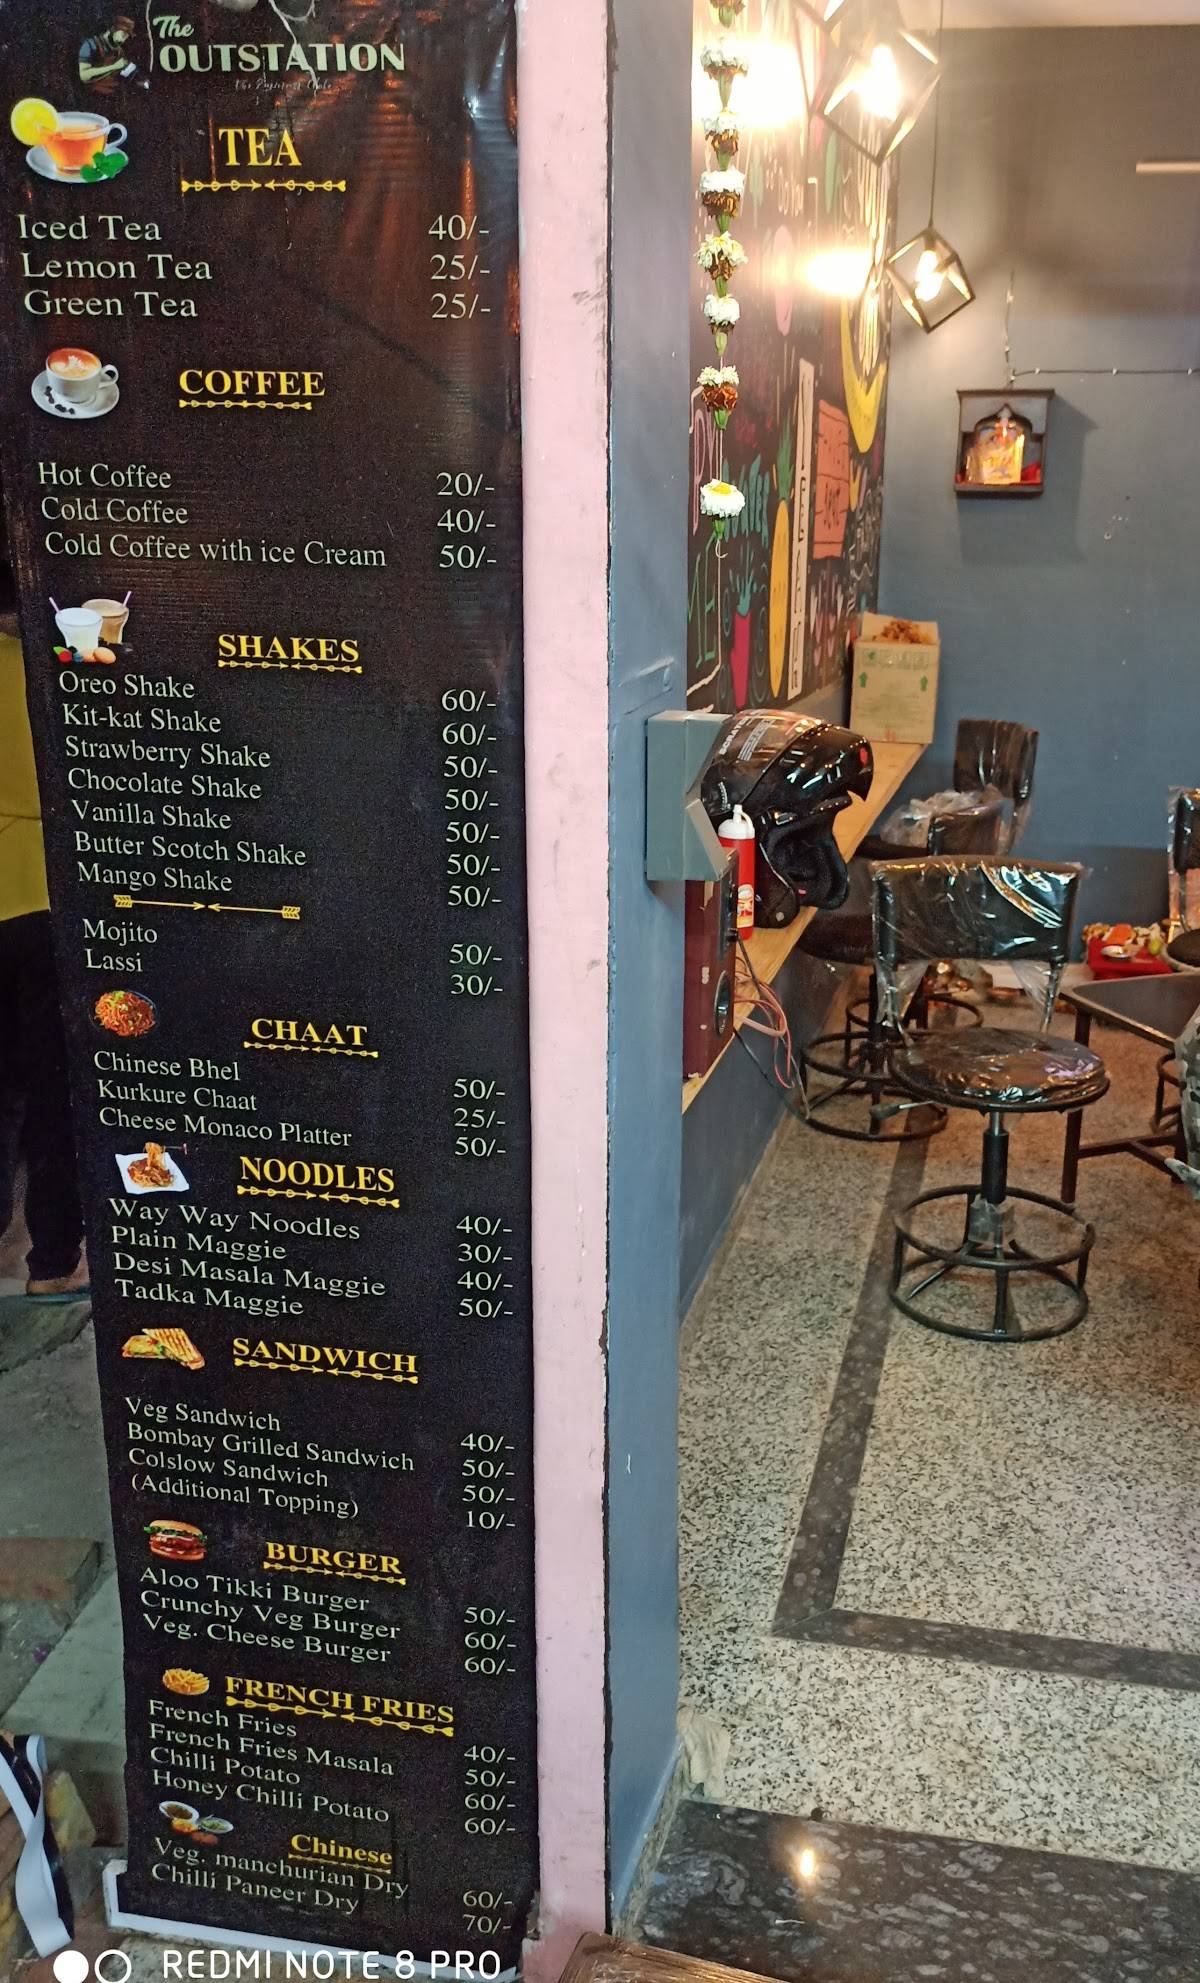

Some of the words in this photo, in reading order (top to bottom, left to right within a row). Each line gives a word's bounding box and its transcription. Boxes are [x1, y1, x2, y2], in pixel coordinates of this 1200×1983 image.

[153, 16, 193, 38] The
[159, 43, 405, 72] OUTSTATION
[219, 128, 301, 166] TEA
[18, 214, 88, 240] Iced
[99, 216, 161, 241] Tea
[429, 214, 489, 241] 40/-
[22, 253, 136, 279] Lemon
[148, 255, 212, 280] Tea
[431, 254, 490, 281] 25/-
[25, 291, 123, 317] Green
[134, 292, 197, 318] Tea
[431, 293, 491, 320] 25/-
[180, 370, 325, 396] COFFEE
[38, 463, 82, 487] Hot
[90, 464, 171, 488] Coffee
[437, 472, 494, 497] 20/-
[41, 497, 98, 522] Cold
[106, 499, 188, 524] Coffee
[438, 508, 496, 533] 40/-
[45, 532, 101, 556] Cold
[110, 534, 190, 559] Coffee
[200, 538, 252, 562] with
[261, 540, 295, 563] ice
[304, 541, 386, 567] Cream
[439, 544, 496, 569] 50/-
[219, 634, 360, 663] SHAKES
[59, 671, 116, 695] Oreo
[124, 675, 195, 699] Shake
[442, 689, 496, 713] 60/-
[63, 704, 143, 729] Kit-kat
[151, 708, 221, 733] Shake
[442, 723, 497, 746] 60/-
[66, 737, 191, 768] Strawberry
[201, 742, 271, 768] Shake
[444, 757, 498, 779] 50/-
[68, 768, 183, 795] Chocolate
[191, 774, 261, 800] Shake
[444, 789, 499, 812] 50/-
[71, 800, 155, 826] Vanilla
[162, 805, 231, 830] Shake
[446, 822, 500, 844] 50/-
[75, 832, 144, 857] Butter
[153, 836, 228, 862] Scotch
[237, 841, 306, 866] Shake
[447, 854, 500, 876] 50/-
[78, 862, 156, 891] Mango
[164, 867, 232, 892] Shake
[448, 885, 501, 908] 50/-
[83, 919, 158, 946] Mojito
[450, 944, 502, 966] 50/-
[85, 948, 143, 973] Lassi
[450, 975, 503, 997] 30/-
[251, 1018, 367, 1046] CHAAT
[94, 1050, 181, 1077] Chinese
[189, 1058, 240, 1081] Bhel
[454, 1078, 505, 1100] 50/-
[99, 1079, 186, 1105] Kurkure
[194, 1087, 257, 1111] Chaat
[454, 1107, 505, 1129] 25/-
[99, 1107, 176, 1133] Cheese
[184, 1115, 273, 1141] Monaco
[280, 1123, 352, 1147] Platter
[454, 1136, 506, 1158] 50/-
[241, 1156, 395, 1192] NOODLES
[109, 1198, 169, 1226] Way
[178, 1204, 239, 1232] Way
[250, 1212, 360, 1240] Noodles
[457, 1216, 513, 1237] 40/-
[111, 1226, 177, 1250] Plain
[187, 1233, 287, 1262] Maggie
[457, 1244, 513, 1264] 30/-
[114, 1252, 171, 1275] Desi
[181, 1259, 274, 1287] Masala
[283, 1269, 386, 1299] Maggie
[457, 1272, 513, 1292] 40/-
[115, 1279, 195, 1305] Tadka
[204, 1288, 304, 1318] Maggie
[458, 1299, 513, 1319] 50/-
[233, 1337, 418, 1374] SANDWICH
[125, 1396, 168, 1422] Veg
[176, 1402, 281, 1432] Sandwich
[461, 1433, 514, 1453] 40/-
[127, 1422, 215, 1453] Bombay
[222, 1434, 298, 1459] Grilled
[306, 1443, 414, 1471] Sandwich
[461, 1459, 515, 1479] 50/-
[129, 1448, 215, 1474] Colslow
[223, 1461, 328, 1488] Sandwich
[462, 1486, 515, 1504] 50/-
[131, 1473, 251, 1504] (Additional
[259, 1488, 359, 1519] Topping)
[465, 1510, 515, 1530] 10/-
[266, 1542, 402, 1574] BURGER
[140, 1567, 199, 1591] Aloo
[206, 1575, 272, 1600] Tikki
[283, 1585, 369, 1613] Burger
[464, 1607, 515, 1626] 50/-
[141, 1590, 242, 1624] Crunchy
[254, 1603, 302, 1629] Veg
[313, 1612, 401, 1640] Burger
[464, 1632, 516, 1651] 60/-
[143, 1613, 198, 1640] Veg.
[207, 1623, 295, 1651] Cheese
[305, 1635, 391, 1664] Burger
[465, 1657, 516, 1675] 60/-
[226, 1676, 353, 1710] FRENCH
[363, 1696, 454, 1724] FRIES
[148, 1700, 228, 1728] French
[239, 1711, 297, 1738] Fries
[464, 1746, 515, 1763] 40/-
[148, 1723, 230, 1752] French
[239, 1736, 298, 1762] Fries
[306, 1747, 394, 1776] Masala
[465, 1769, 515, 1787] 50/-
[150, 1747, 215, 1774] Chilli
[226, 1759, 300, 1785] Potato
[464, 1794, 515, 1812] 60/-
[153, 1770, 228, 1800] Honey
[237, 1784, 303, 1810] Chilli
[314, 1796, 389, 1823] Potato
[464, 1817, 515, 1835] 60/-
[290, 1834, 392, 1866] Chinese
[153, 1837, 205, 1865] Veg.
[216, 1853, 354, 1887] manchurian
[364, 1873, 409, 1899] Dry
[463, 1890, 512, 1909] 60/-
[151, 1863, 217, 1891] Chilli
[226, 1877, 306, 1905] Paneer
[315, 1889, 359, 1916] Dry
[463, 1915, 511, 1935] 70/-
